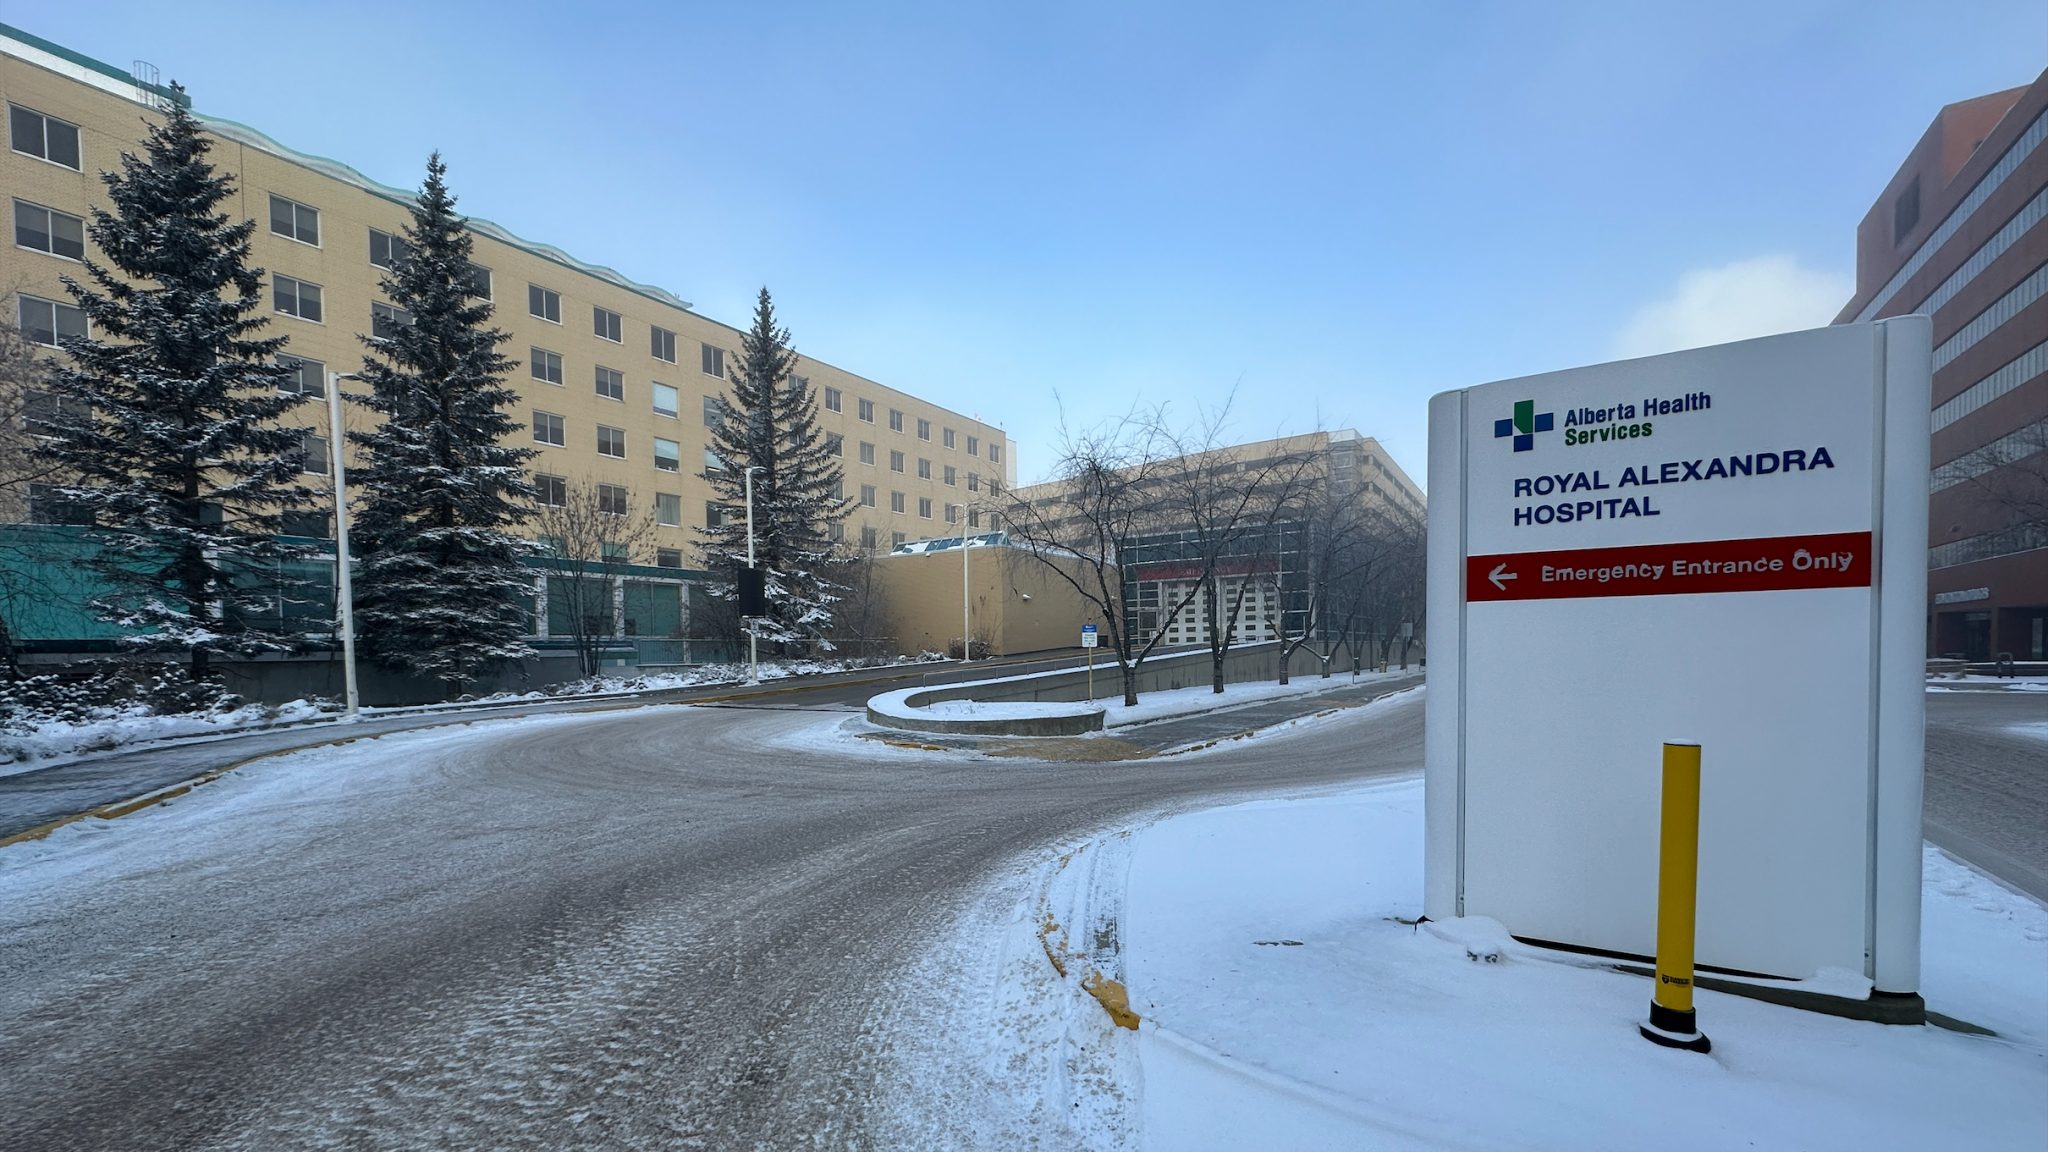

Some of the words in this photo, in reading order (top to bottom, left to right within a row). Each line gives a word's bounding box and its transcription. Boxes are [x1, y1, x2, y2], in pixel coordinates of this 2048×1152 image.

[1564, 404, 1636, 427] Alberta
[1643, 391, 1712, 417] Health
[1565, 421, 1653, 446] Services
[1514, 470, 1610, 497] ROYAL
[1618, 447, 1835, 488] ALEXANDRA
[1514, 496, 1660, 526] HOSPITAL
[1541, 562, 1665, 583] Emergency
[1672, 556, 1784, 577] Entrance
[1792, 549, 1854, 573] Only
